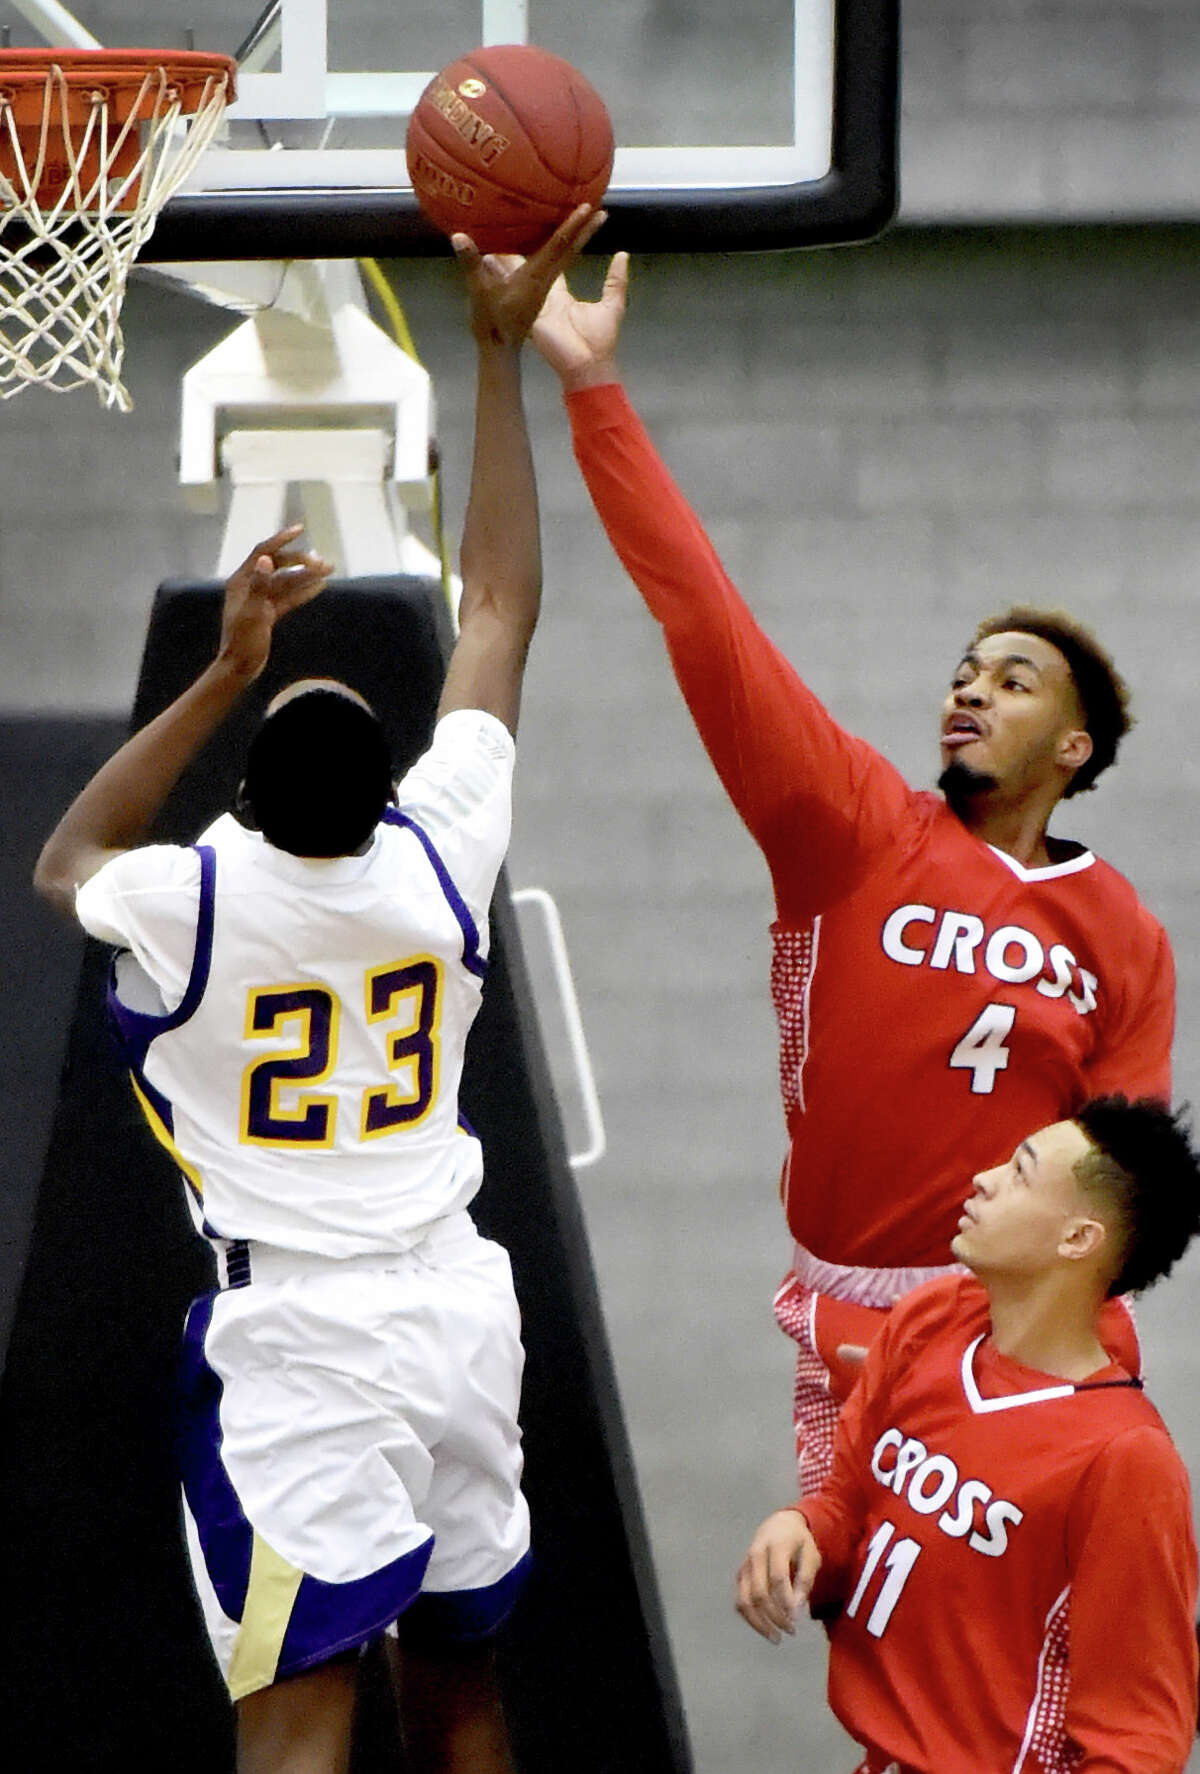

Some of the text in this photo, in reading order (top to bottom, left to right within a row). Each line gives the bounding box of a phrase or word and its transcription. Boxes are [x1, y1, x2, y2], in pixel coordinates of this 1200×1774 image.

[424, 80, 511, 168] DING
[881, 903, 1099, 1015] CROSS
[239, 952, 445, 1149] 23
[949, 1003, 1017, 1094] 4
[870, 1427, 1025, 1557] CROSS
[846, 1520, 922, 1638] 11
